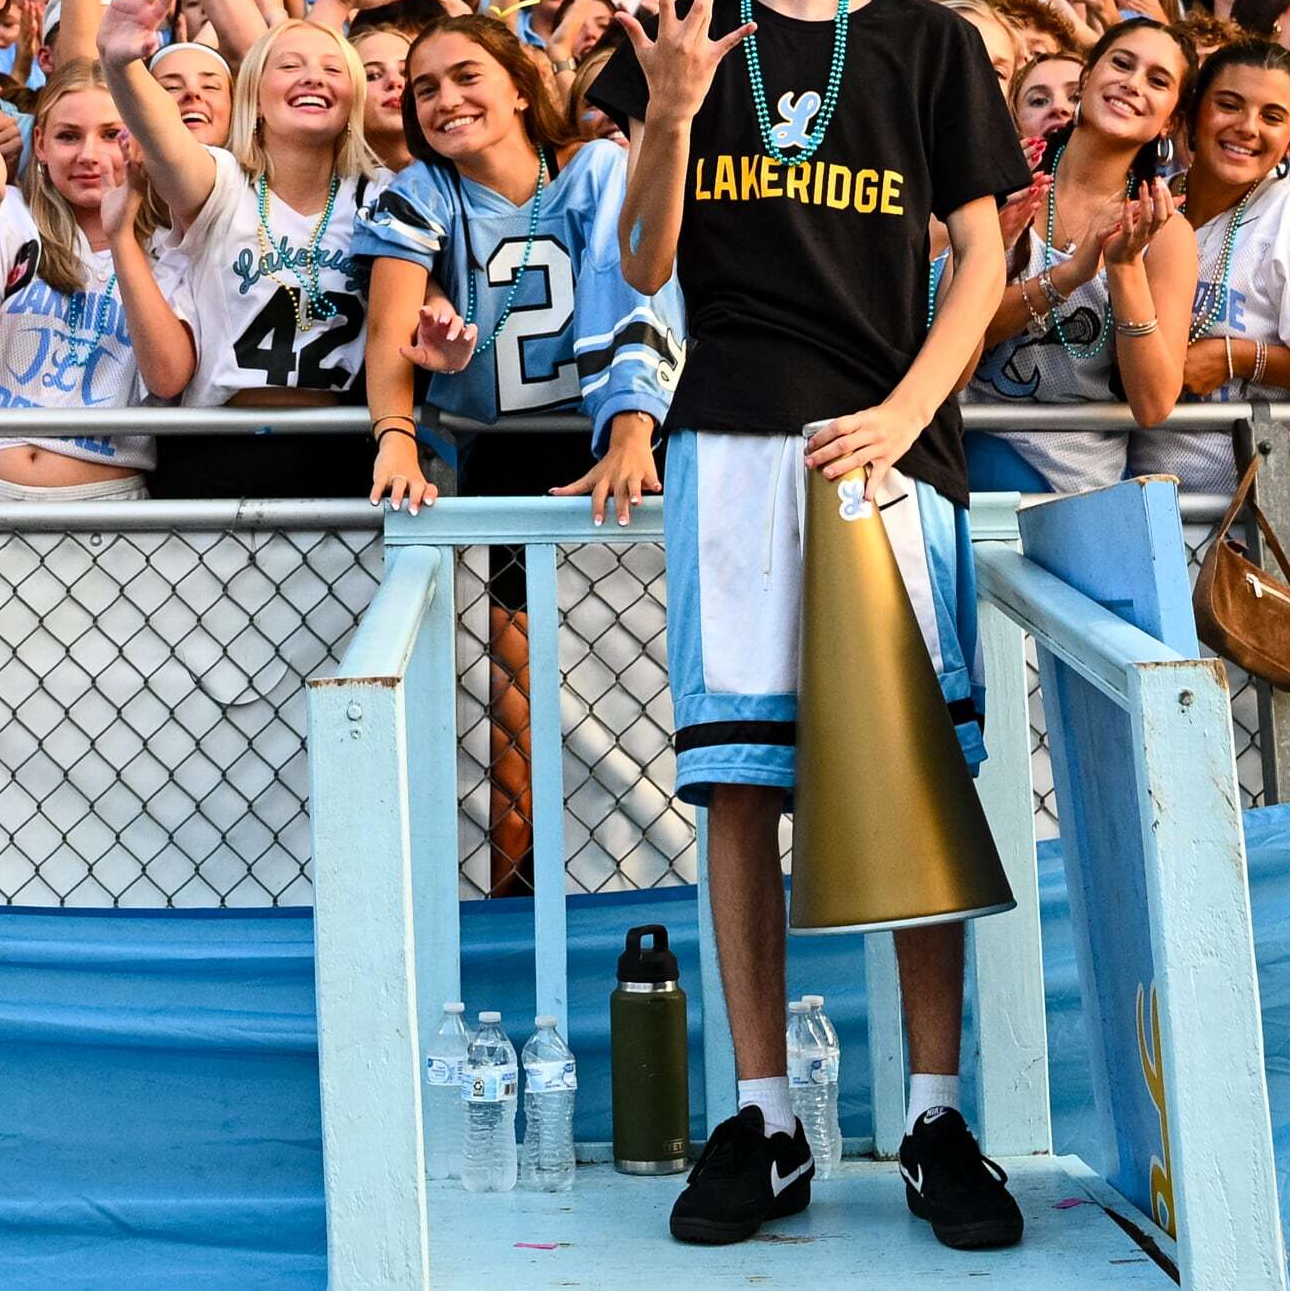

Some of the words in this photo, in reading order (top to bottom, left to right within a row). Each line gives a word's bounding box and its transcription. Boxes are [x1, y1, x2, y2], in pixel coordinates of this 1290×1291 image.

[695, 154, 904, 216] LAKERIDGE
[233, 285, 366, 389] 42
[486, 234, 583, 417] 2
